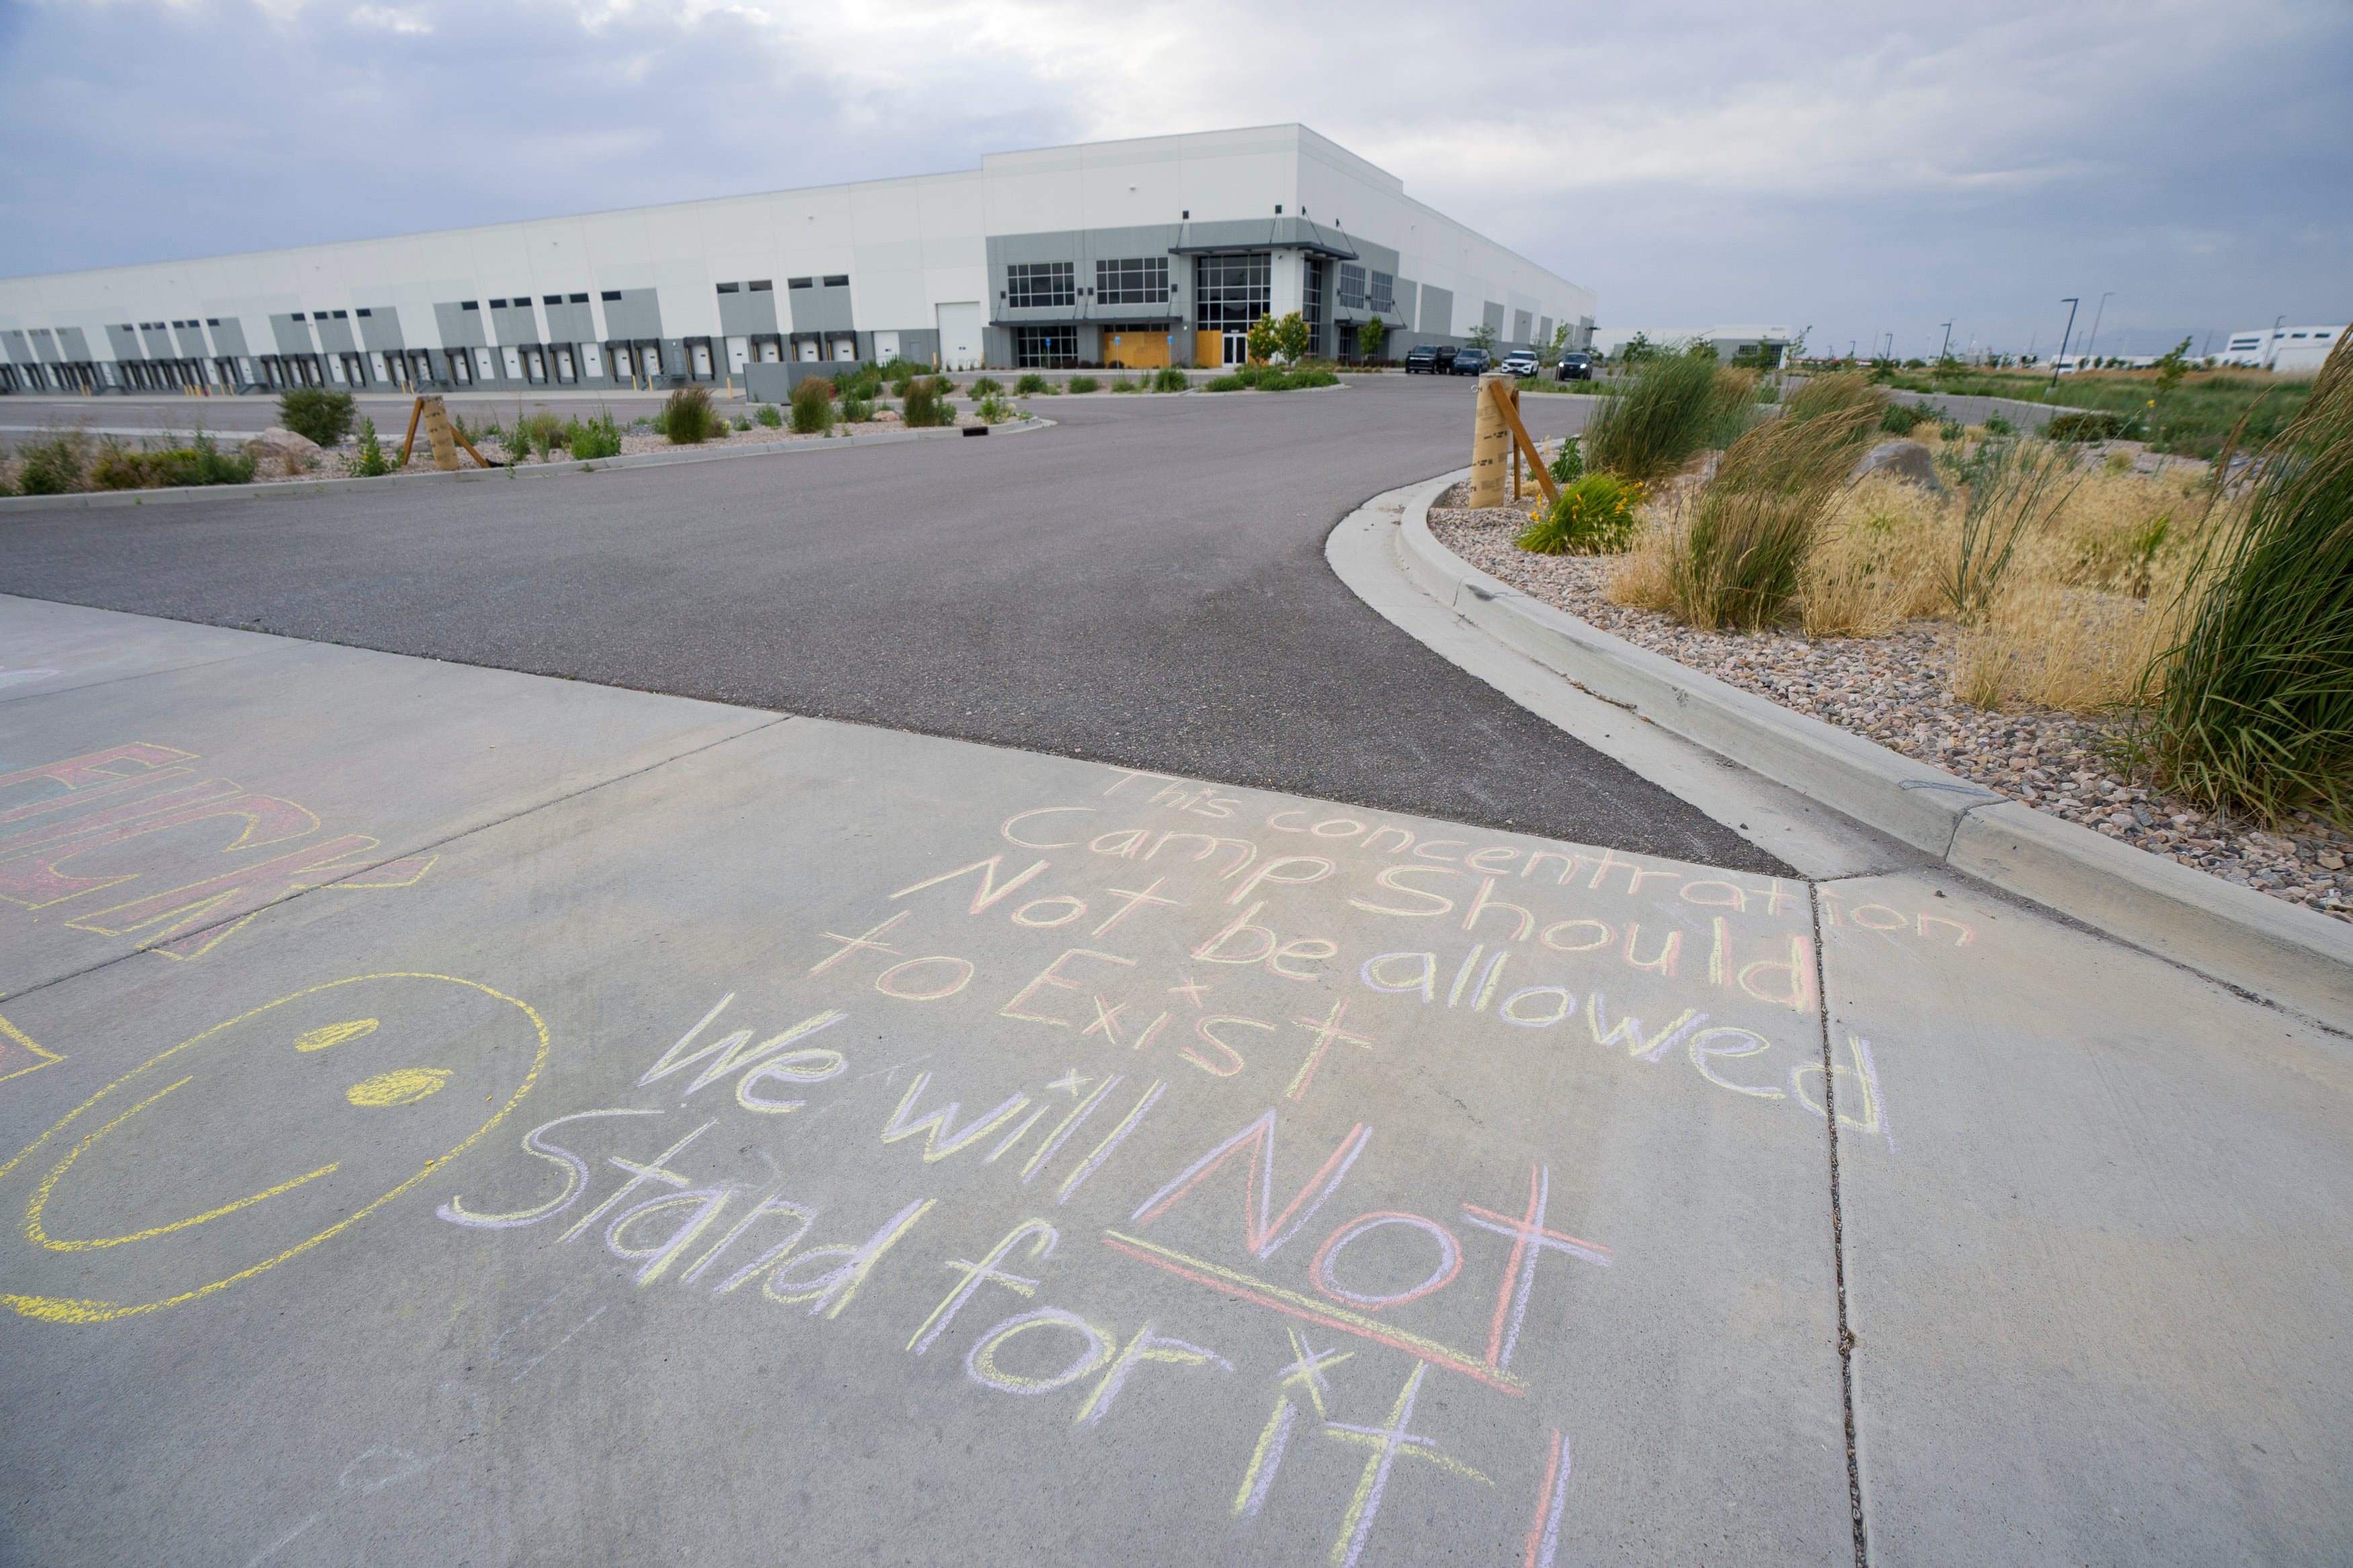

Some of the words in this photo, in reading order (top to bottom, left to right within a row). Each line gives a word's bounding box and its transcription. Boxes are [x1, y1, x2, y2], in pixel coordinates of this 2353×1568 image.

[0, 741, 441, 962] FUCK
[808, 910, 975, 1001] to
[1000, 806, 1336, 905] Camp
[1347, 864, 1814, 1014] Should
[1103, 766, 1242, 819] This
[1266, 810, 1975, 947] concentration
[888, 854, 1179, 939] Not
[1191, 899, 1339, 981] be
[1359, 944, 1897, 1153] allowed
[436, 1108, 939, 1320] Stand
[905, 1216, 1235, 1428] for
[635, 992, 849, 1114] We
[881, 1067, 1172, 1207] will
[1131, 1106, 1613, 1371] Not
